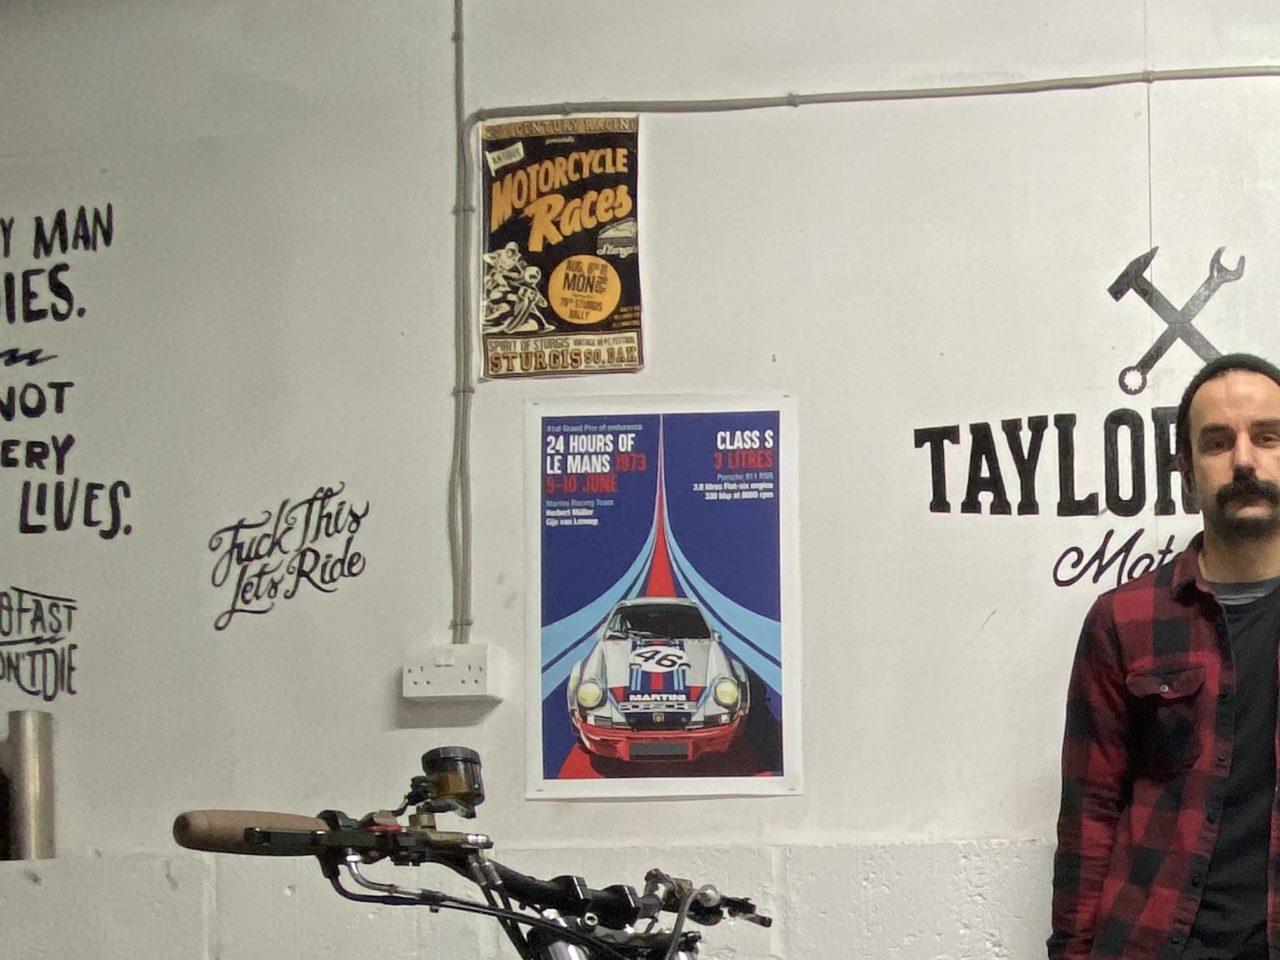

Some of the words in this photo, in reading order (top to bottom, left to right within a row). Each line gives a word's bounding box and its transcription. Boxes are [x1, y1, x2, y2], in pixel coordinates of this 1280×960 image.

[515, 119, 579, 136] CENTURY
[490, 147, 629, 234] MOTORCYCLE
[521, 184, 633, 252] Races
[33, 202, 114, 260] MAN
[562, 271, 596, 293] MON
[488, 340, 518, 353] SPIRIT
[520, 339, 532, 351] OF
[533, 337, 570, 350] STURGIS
[489, 348, 582, 373] STURGIS
[546, 435, 565, 454] 24
[569, 433, 614, 453] HOURS
[618, 433, 636, 452] OF
[716, 429, 760, 450] CLASS
[764, 429, 774, 449] S
[546, 455, 562, 475] LE
[566, 454, 611, 474] MANS
[615, 452, 647, 472] 1973
[713, 450, 723, 471] 3
[728, 449, 773, 470] LITRES
[913, 406, 1200, 518] TAYLOR
[582, 473, 618, 493] JUNE
[19, 477, 132, 540] LIVES.
[208, 498, 294, 588] Fuck
[284, 480, 370, 553] This
[283, 535, 367, 600] Ride
[634, 649, 684, 668] 46
[628, 693, 687, 702] MARTINI
